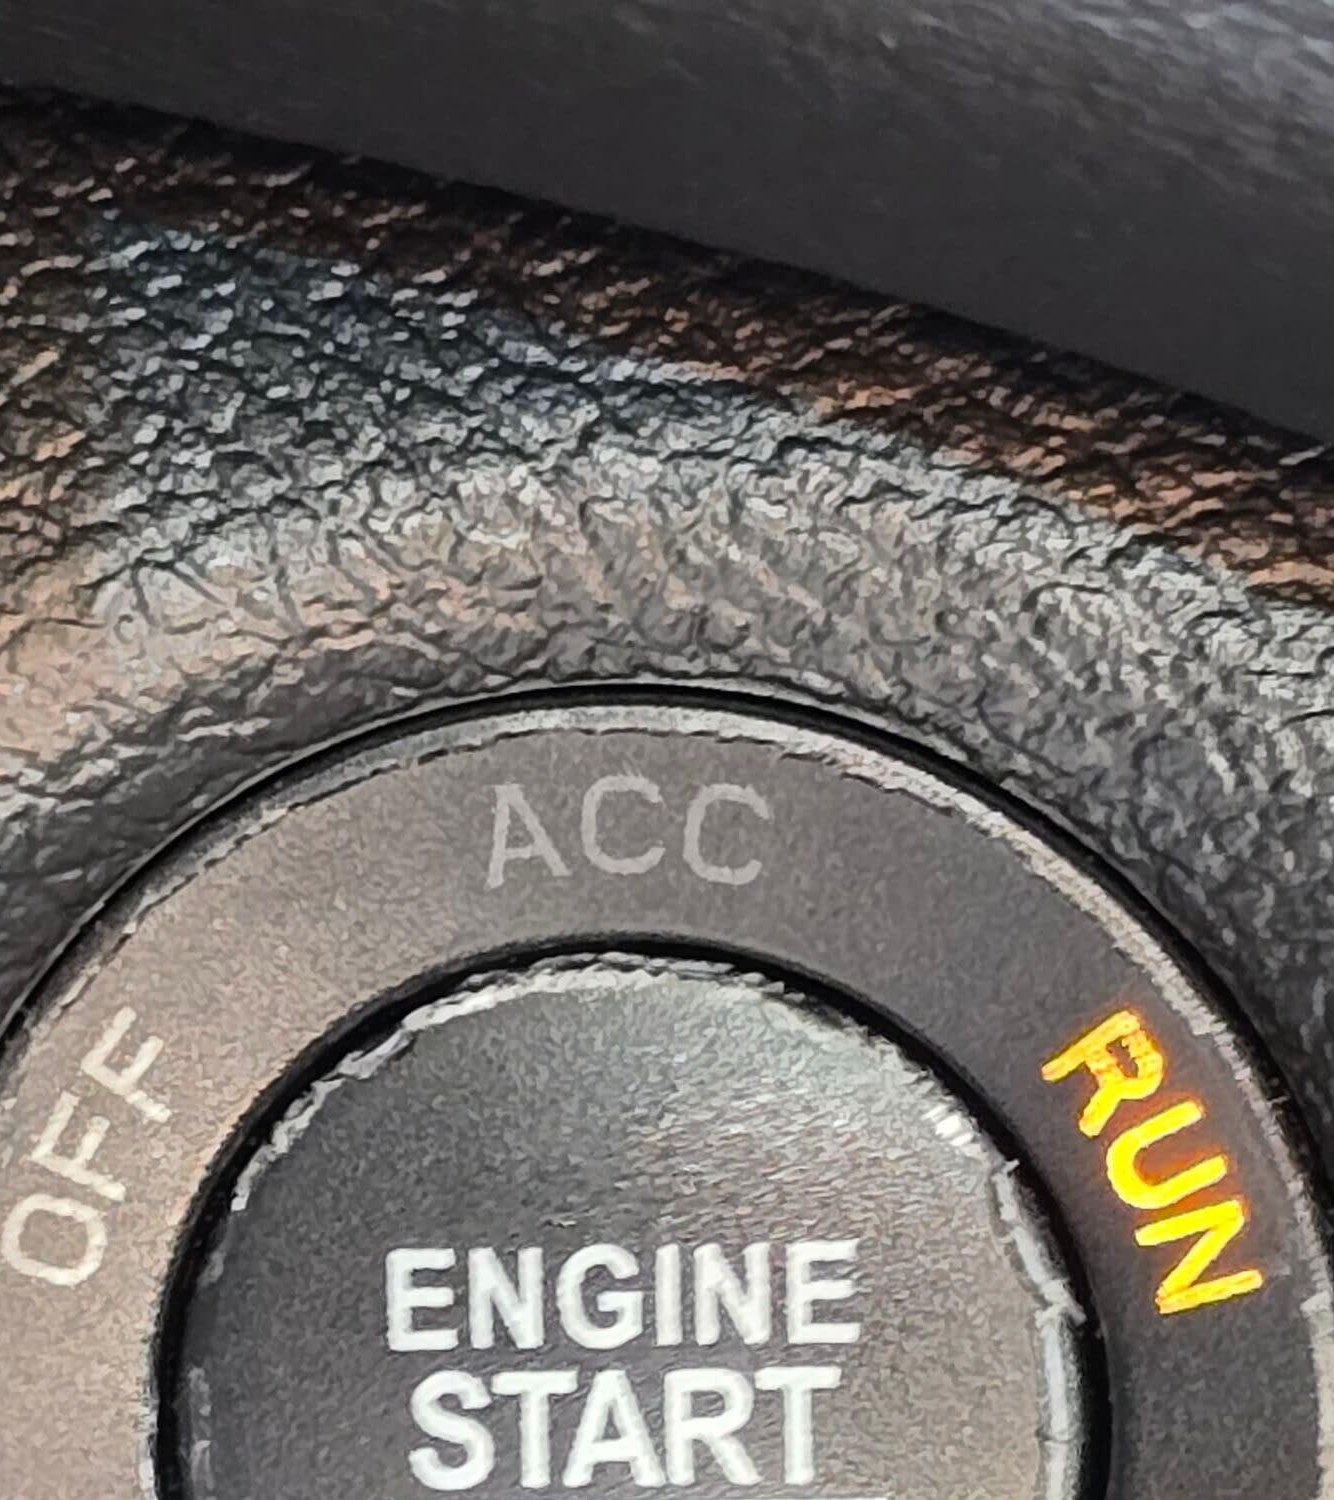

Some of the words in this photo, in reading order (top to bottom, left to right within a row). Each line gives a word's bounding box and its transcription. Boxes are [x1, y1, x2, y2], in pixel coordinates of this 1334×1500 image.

[484, 774, 773, 889] ACC
[0, 1005, 174, 1286] OFF
[1038, 1008, 1263, 1315] RUN
[384, 1239, 862, 1352] ENGINE
[408, 1366, 842, 1491] START
